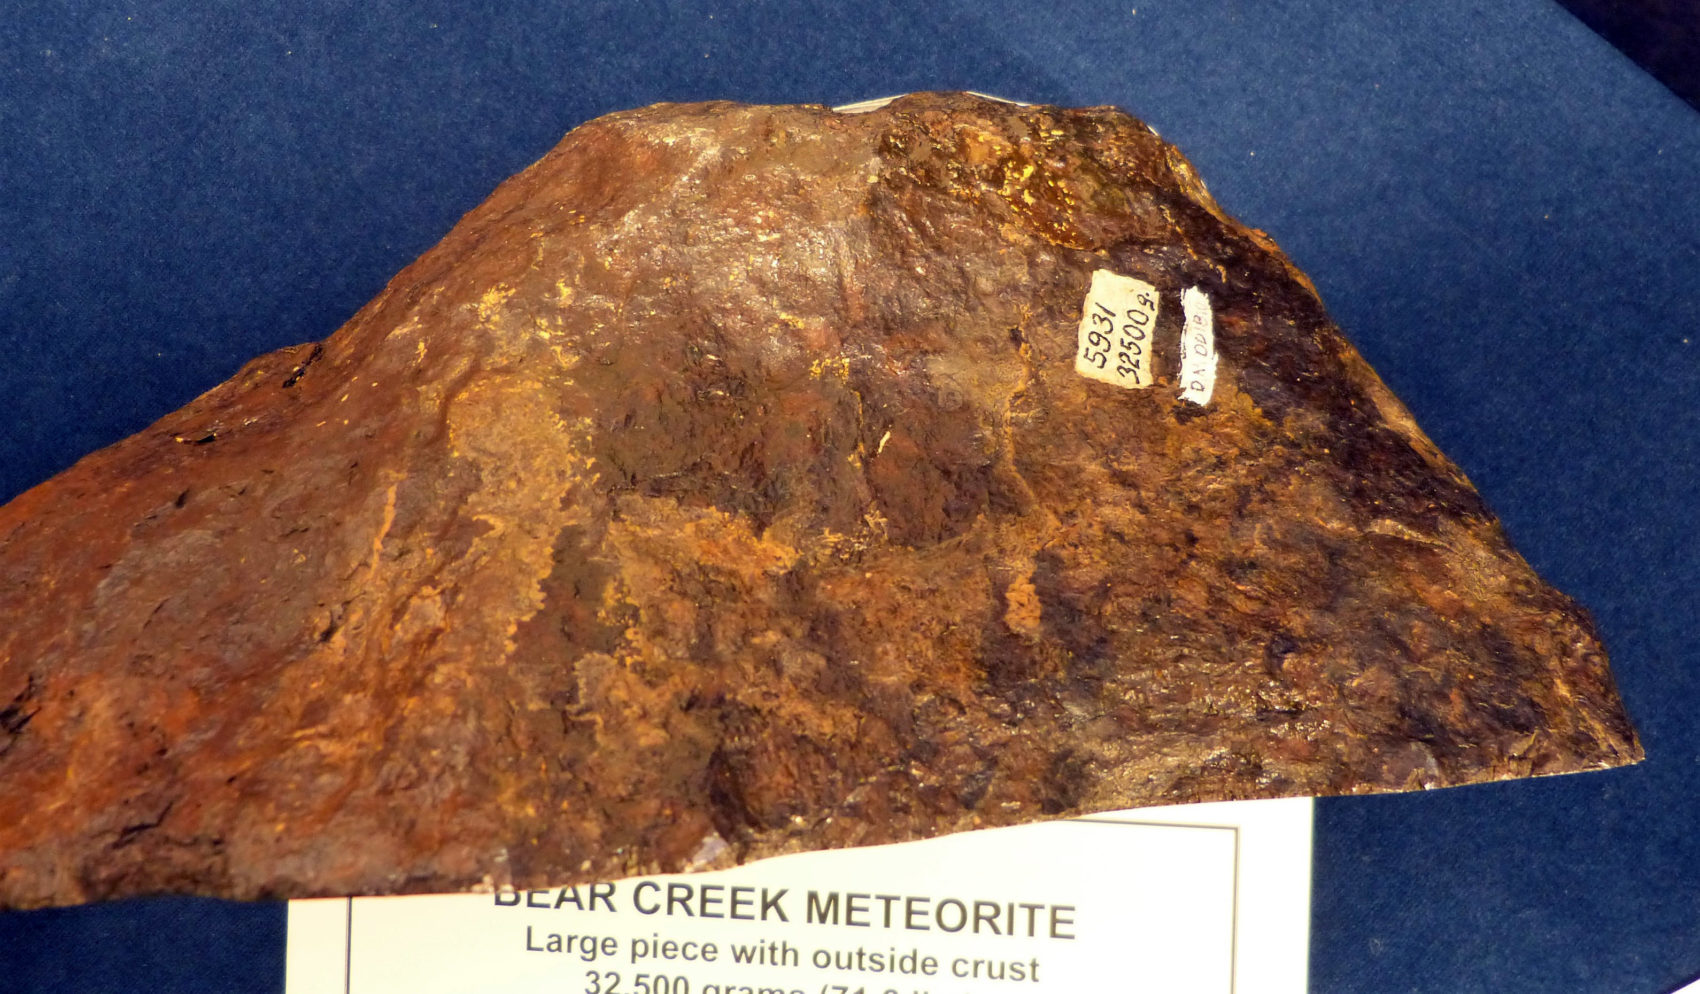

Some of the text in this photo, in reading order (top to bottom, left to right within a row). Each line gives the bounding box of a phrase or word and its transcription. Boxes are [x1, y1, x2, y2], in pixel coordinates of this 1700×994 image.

[1083, 302, 1117, 370] 5931
[632, 881, 790, 922] CREEK
[806, 890, 1076, 940] METEORITE
[526, 925, 1040, 982] Large piece with outside crust
[585, 970, 690, 994] 32500
